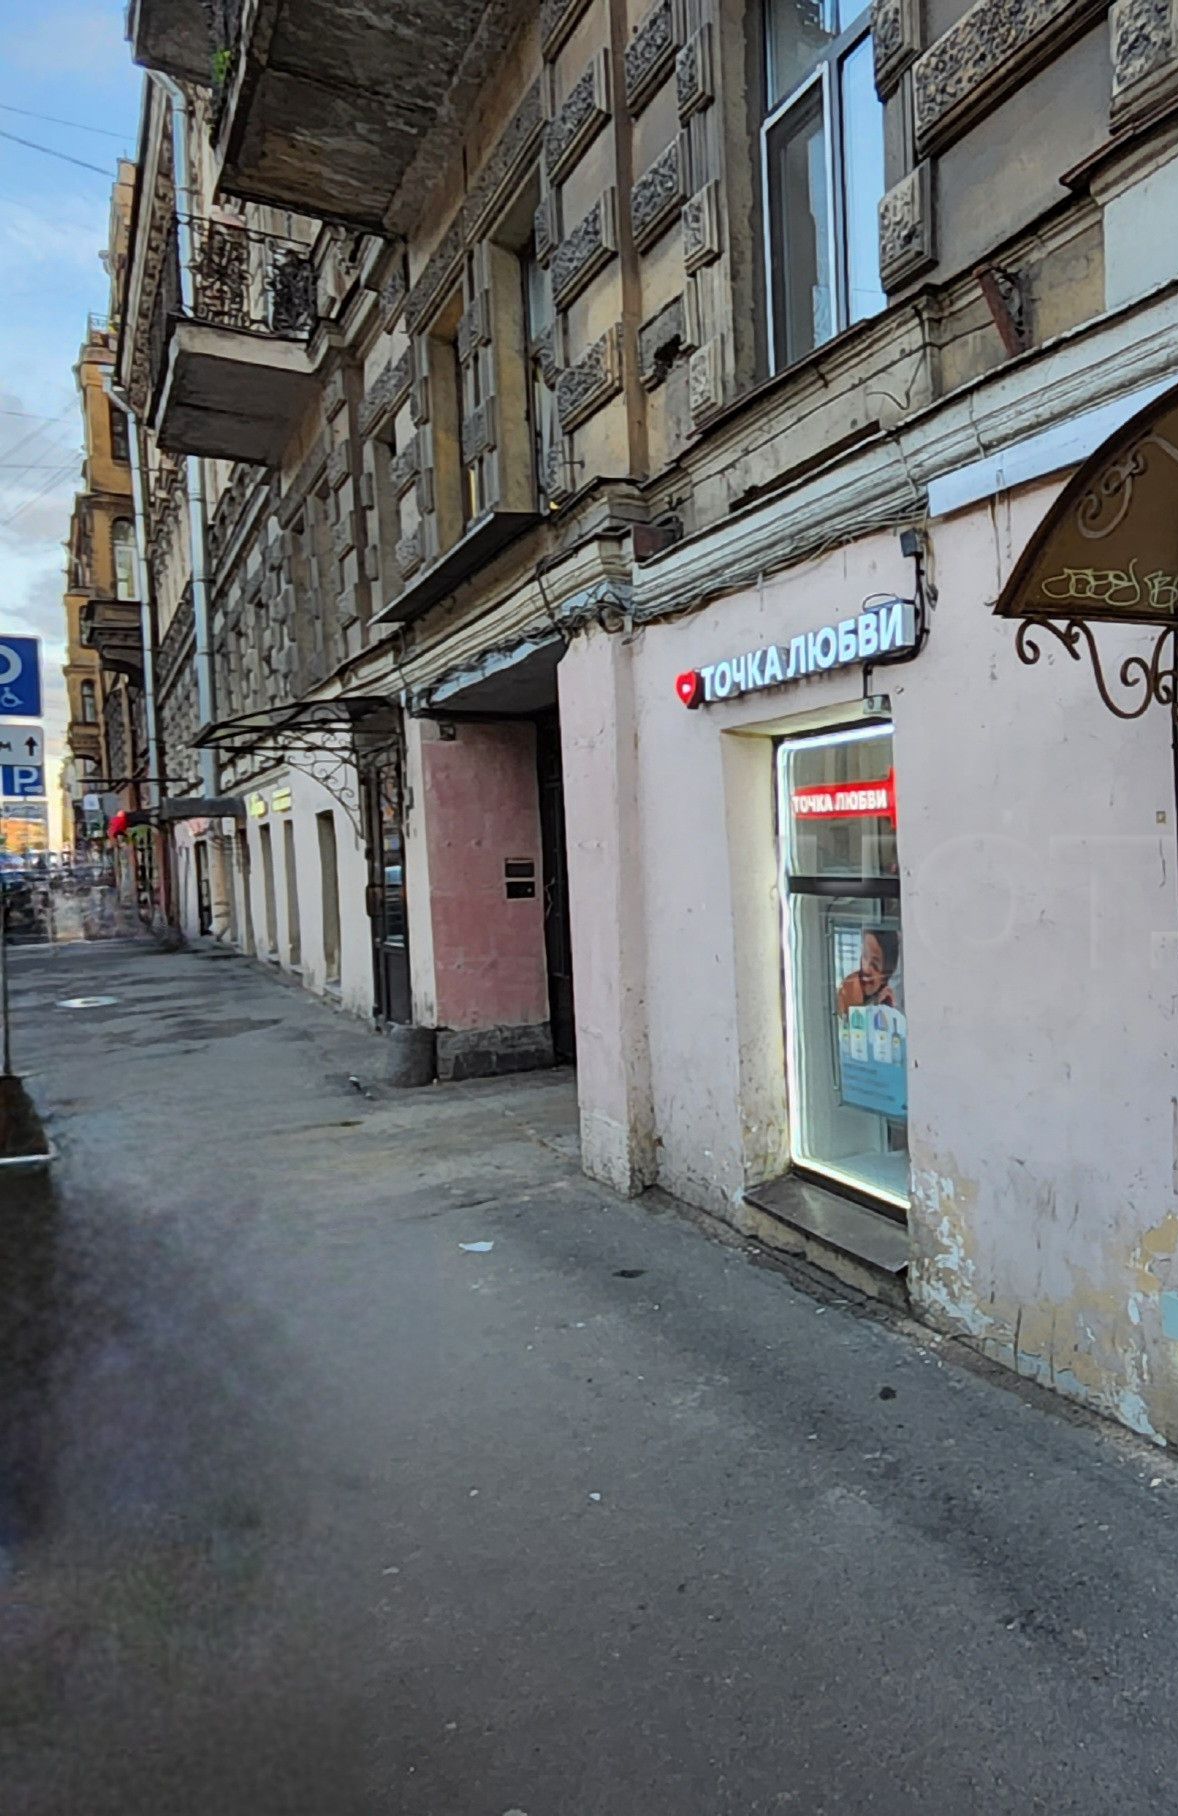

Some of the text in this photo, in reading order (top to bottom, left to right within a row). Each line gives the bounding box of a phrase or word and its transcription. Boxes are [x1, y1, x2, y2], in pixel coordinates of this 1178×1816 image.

[700, 602, 904, 701] ТОЧКА ЛЮБВИ
[792, 788, 888, 813] ТОЧКА ЛЮБВИ
